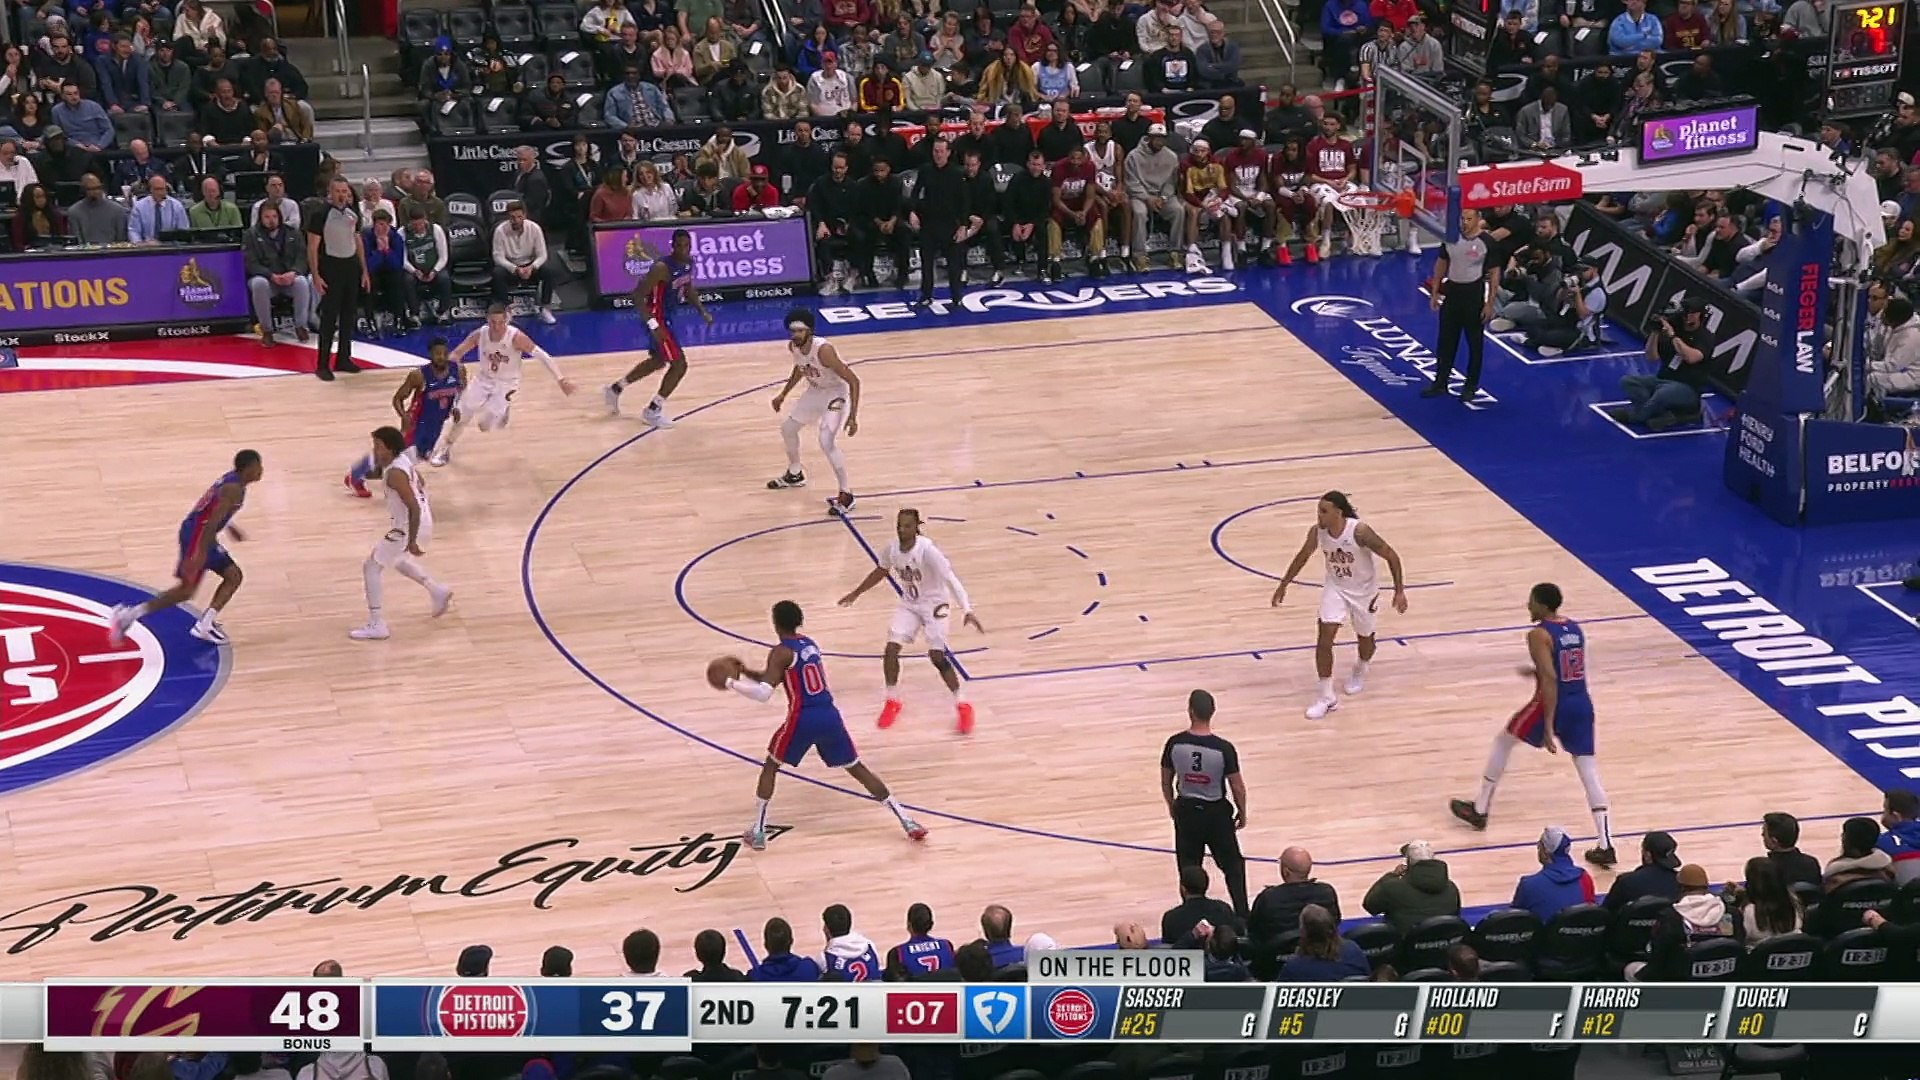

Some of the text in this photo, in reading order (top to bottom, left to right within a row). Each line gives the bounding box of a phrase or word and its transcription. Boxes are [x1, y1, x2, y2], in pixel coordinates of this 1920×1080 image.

[1679, 115, 1738, 140] planet
[1683, 130, 1747, 150] fitness
[453, 145, 489, 161] Little
[688, 229, 766, 255] lanet
[53, 331, 110, 344] StockX
[156, 325, 212, 338] StockX
[1741, 413, 1775, 443] HENRY
[1740, 429, 1766, 454] FORD
[1738, 445, 1776, 478] HEALTH
[1827, 479, 1889, 492] PROPERTY
[1631, 557, 1882, 687] DETROIT
[1560, 648, 1585, 681] 12
[1191, 751, 1203, 772] 3
[0, 824, 794, 955] Platinum Equity
